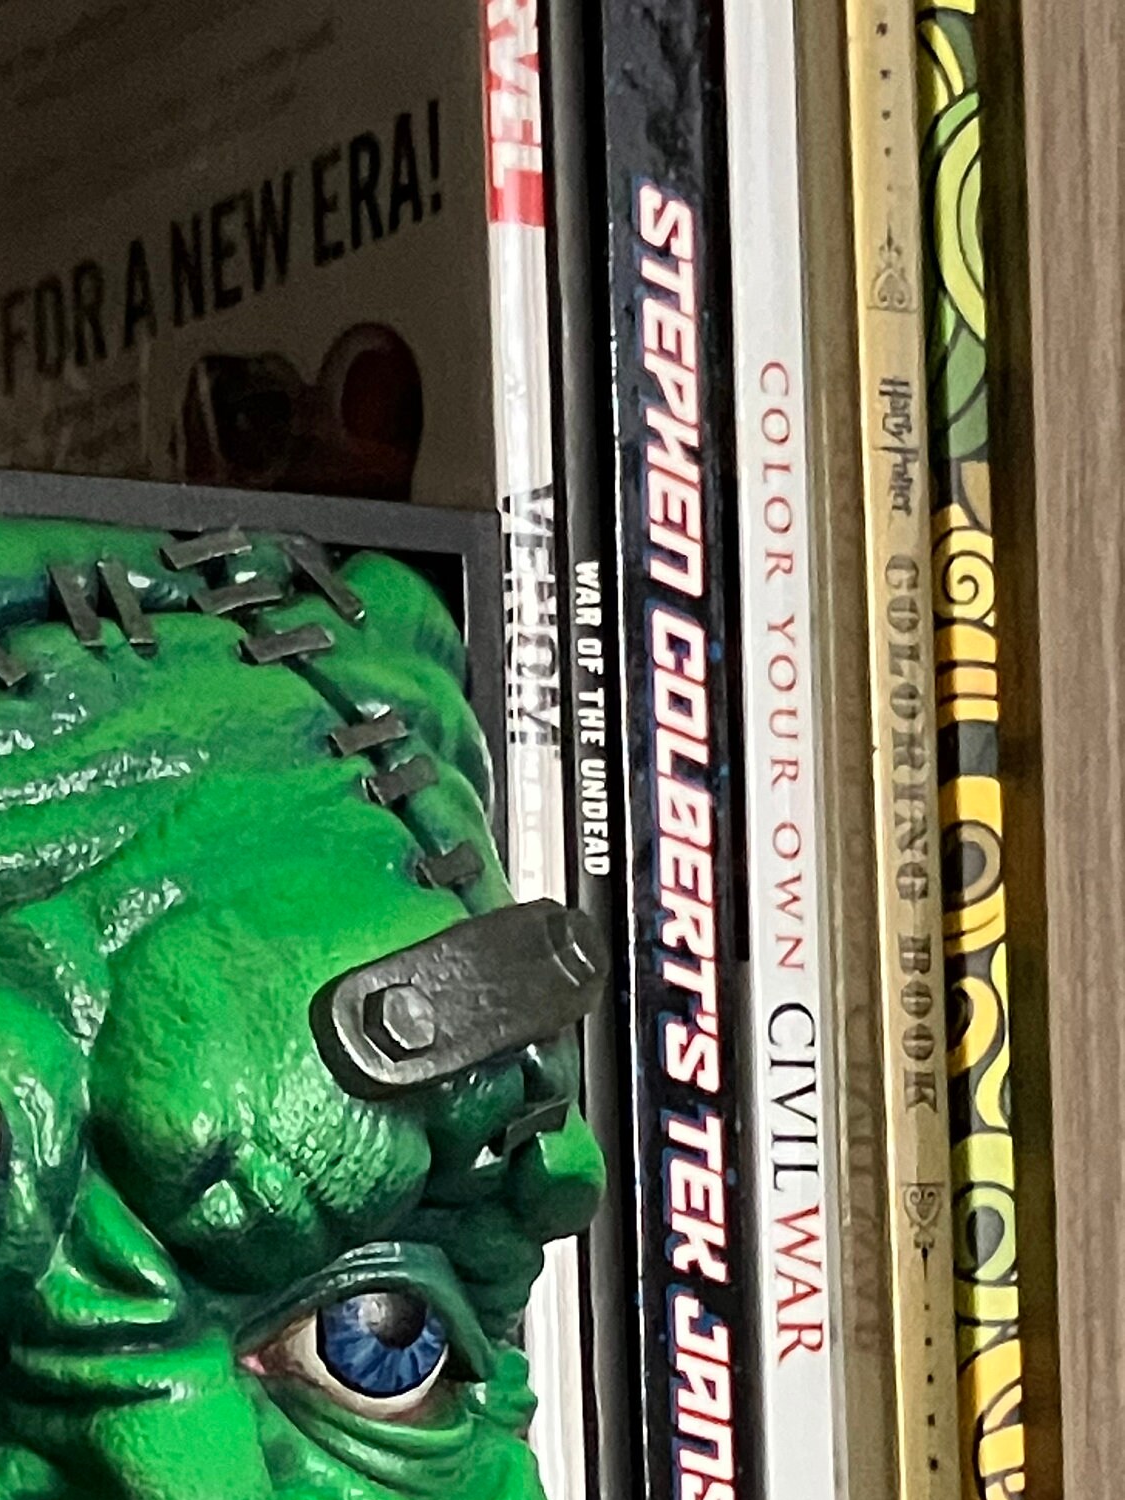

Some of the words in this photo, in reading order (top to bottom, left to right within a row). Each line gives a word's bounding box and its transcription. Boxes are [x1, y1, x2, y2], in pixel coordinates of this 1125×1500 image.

[1, 258, 107, 397] FOR
[123, 236, 158, 349] A
[170, 170, 294, 328] NEW
[311, 99, 442, 268] ERA!
[639, 183, 704, 599] STEPHEN
[758, 360, 796, 582] COLOR
[501, 483, 561, 746] VENOM
[575, 560, 601, 628] WAR
[577, 637, 605, 678] OF
[577, 687, 609, 744] THE
[766, 614, 801, 788] YOUR
[884, 554, 930, 901] COLORING
[579, 758, 612, 877] UNDEAD
[651, 608, 720, 1094] COLBERT'S
[771, 821, 805, 972] OWN
[767, 1001, 820, 1193] CIVIL
[898, 931, 939, 1115] BOOK
[667, 1112, 730, 1285] TEK
[774, 1204, 825, 1363] WAR
